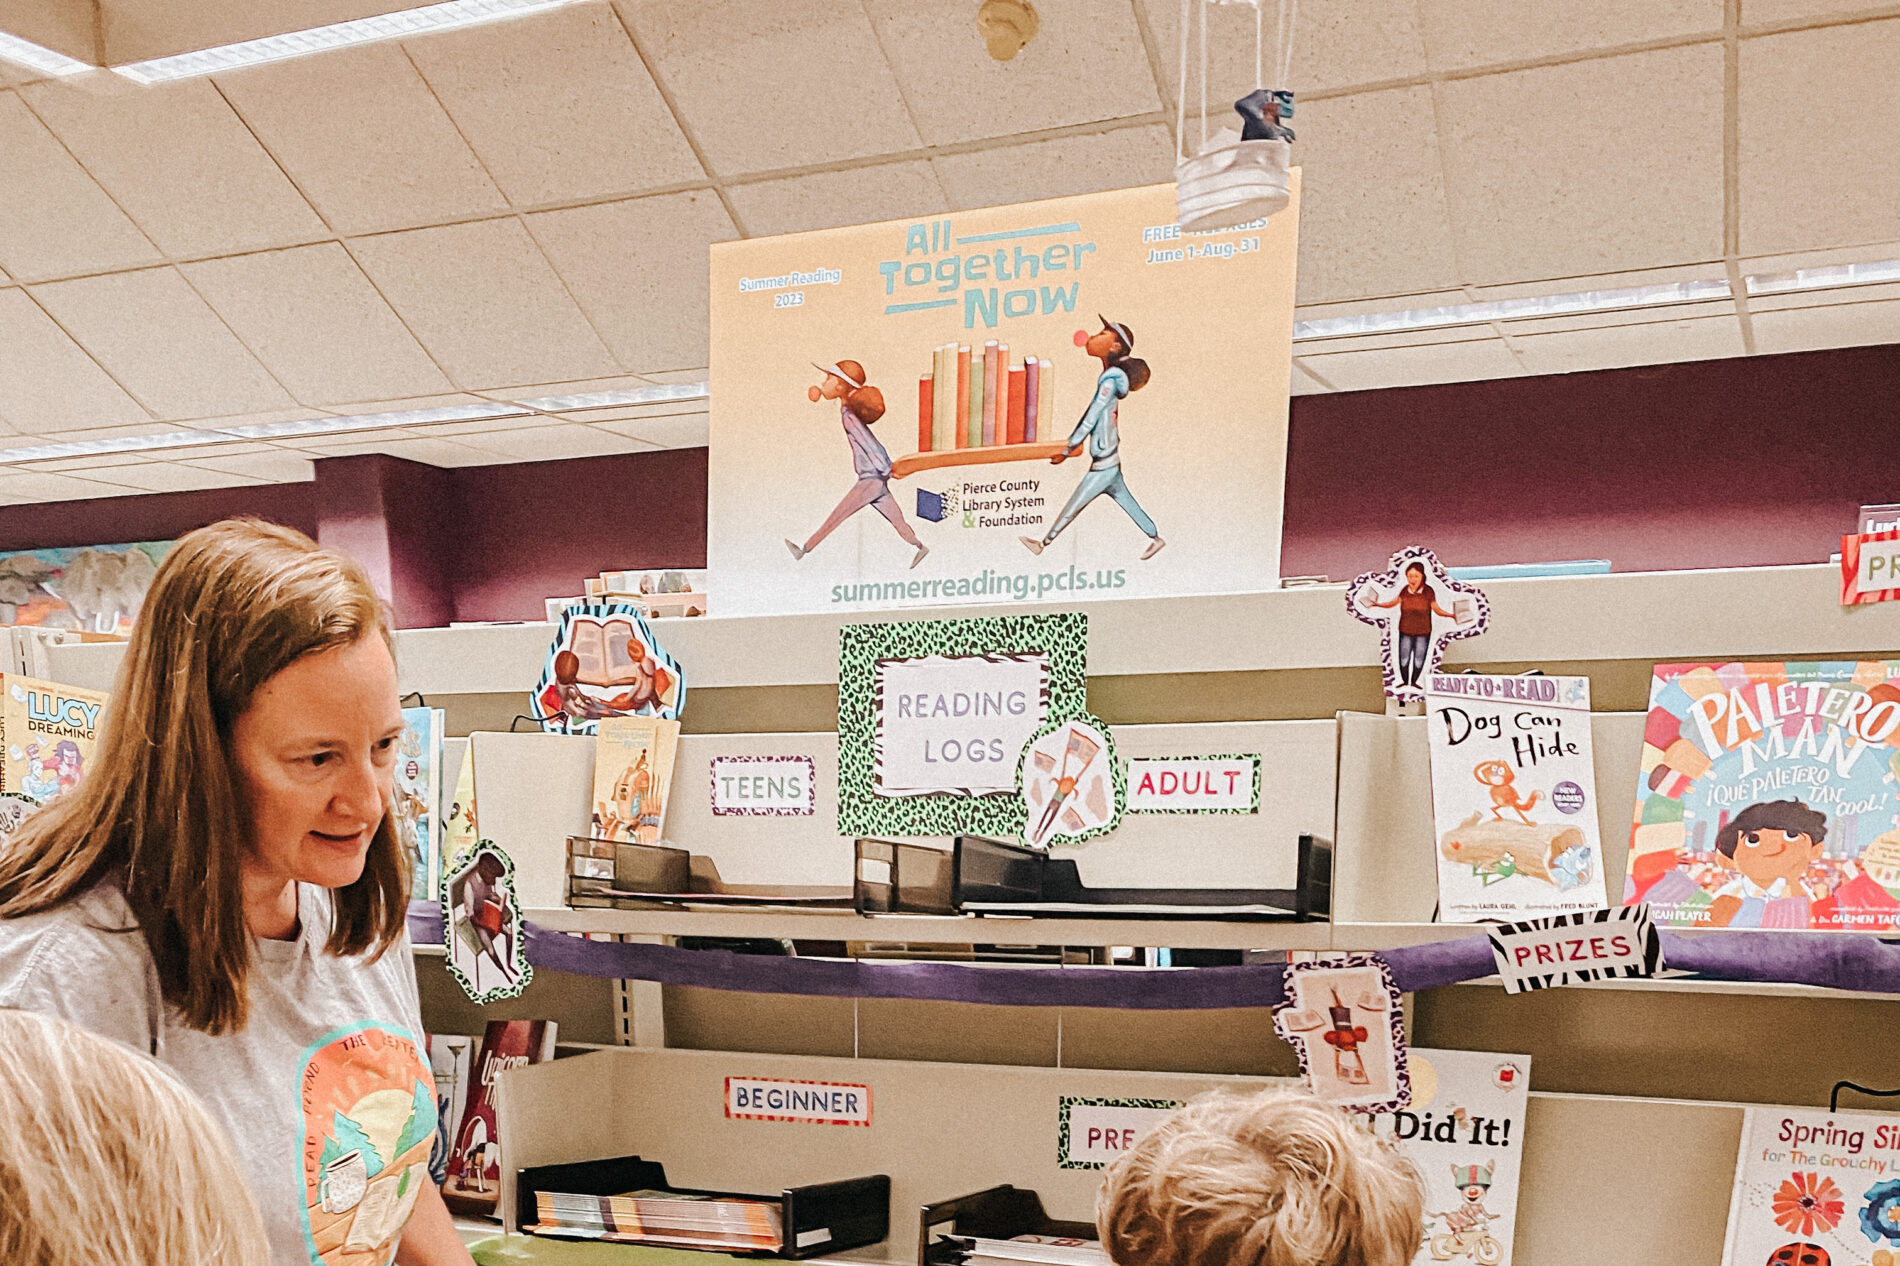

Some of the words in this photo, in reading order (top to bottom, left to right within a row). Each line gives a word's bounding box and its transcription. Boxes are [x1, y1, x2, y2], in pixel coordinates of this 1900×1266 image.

[907, 220, 951, 255] All
[1143, 225, 1180, 242] FREE
[1147, 250, 1183, 263] June
[1241, 238, 1260, 251] 31
[740, 277, 791, 292] Summer
[790, 269, 841, 287] Reading
[879, 241, 1097, 295] Together
[775, 292, 804, 307] 2023
[964, 282, 1080, 329] Now
[962, 482, 997, 495] Pierce
[999, 479, 1041, 493] County
[962, 499, 1002, 513] Library
[1004, 496, 1045, 511] System
[961, 510, 976, 528] &
[978, 513, 1043, 528] Foundation
[832, 565, 1126, 603] summerreading.pcls.us
[28, 691, 101, 729] LUCY
[898, 691, 1027, 719] READING
[28, 720, 95, 740] DREAMING
[1435, 707, 1502, 746] Dog
[1514, 712, 1561, 730] Can
[1686, 680, 1900, 760] PALETERO
[925, 739, 1004, 763] LOGS
[1511, 731, 1580, 767] Hide
[1739, 716, 1886, 779] MAN
[720, 776, 801, 800] TEENS
[1137, 770, 1241, 797] ADULT
[1706, 778, 1748, 807] ¡QUÉ
[1752, 764, 1830, 800] PALETERO
[1808, 786, 1845, 802] TAN
[1836, 793, 1888, 816] COOL!
[1675, 909, 1711, 921] PLAYER
[1832, 913, 1874, 924] CARMEN
[1514, 935, 1632, 968] PRIZES
[338, 1034, 367, 1050] THE
[737, 1087, 858, 1114] BEGINNER
[1395, 1111, 1457, 1143] Did
[1469, 1116, 1511, 1147] It!
[1779, 1118, 1864, 1154] Spring
[1762, 1148, 1786, 1162] for
[1790, 1150, 1816, 1165] The
[1820, 1153, 1887, 1174] Grouchy
